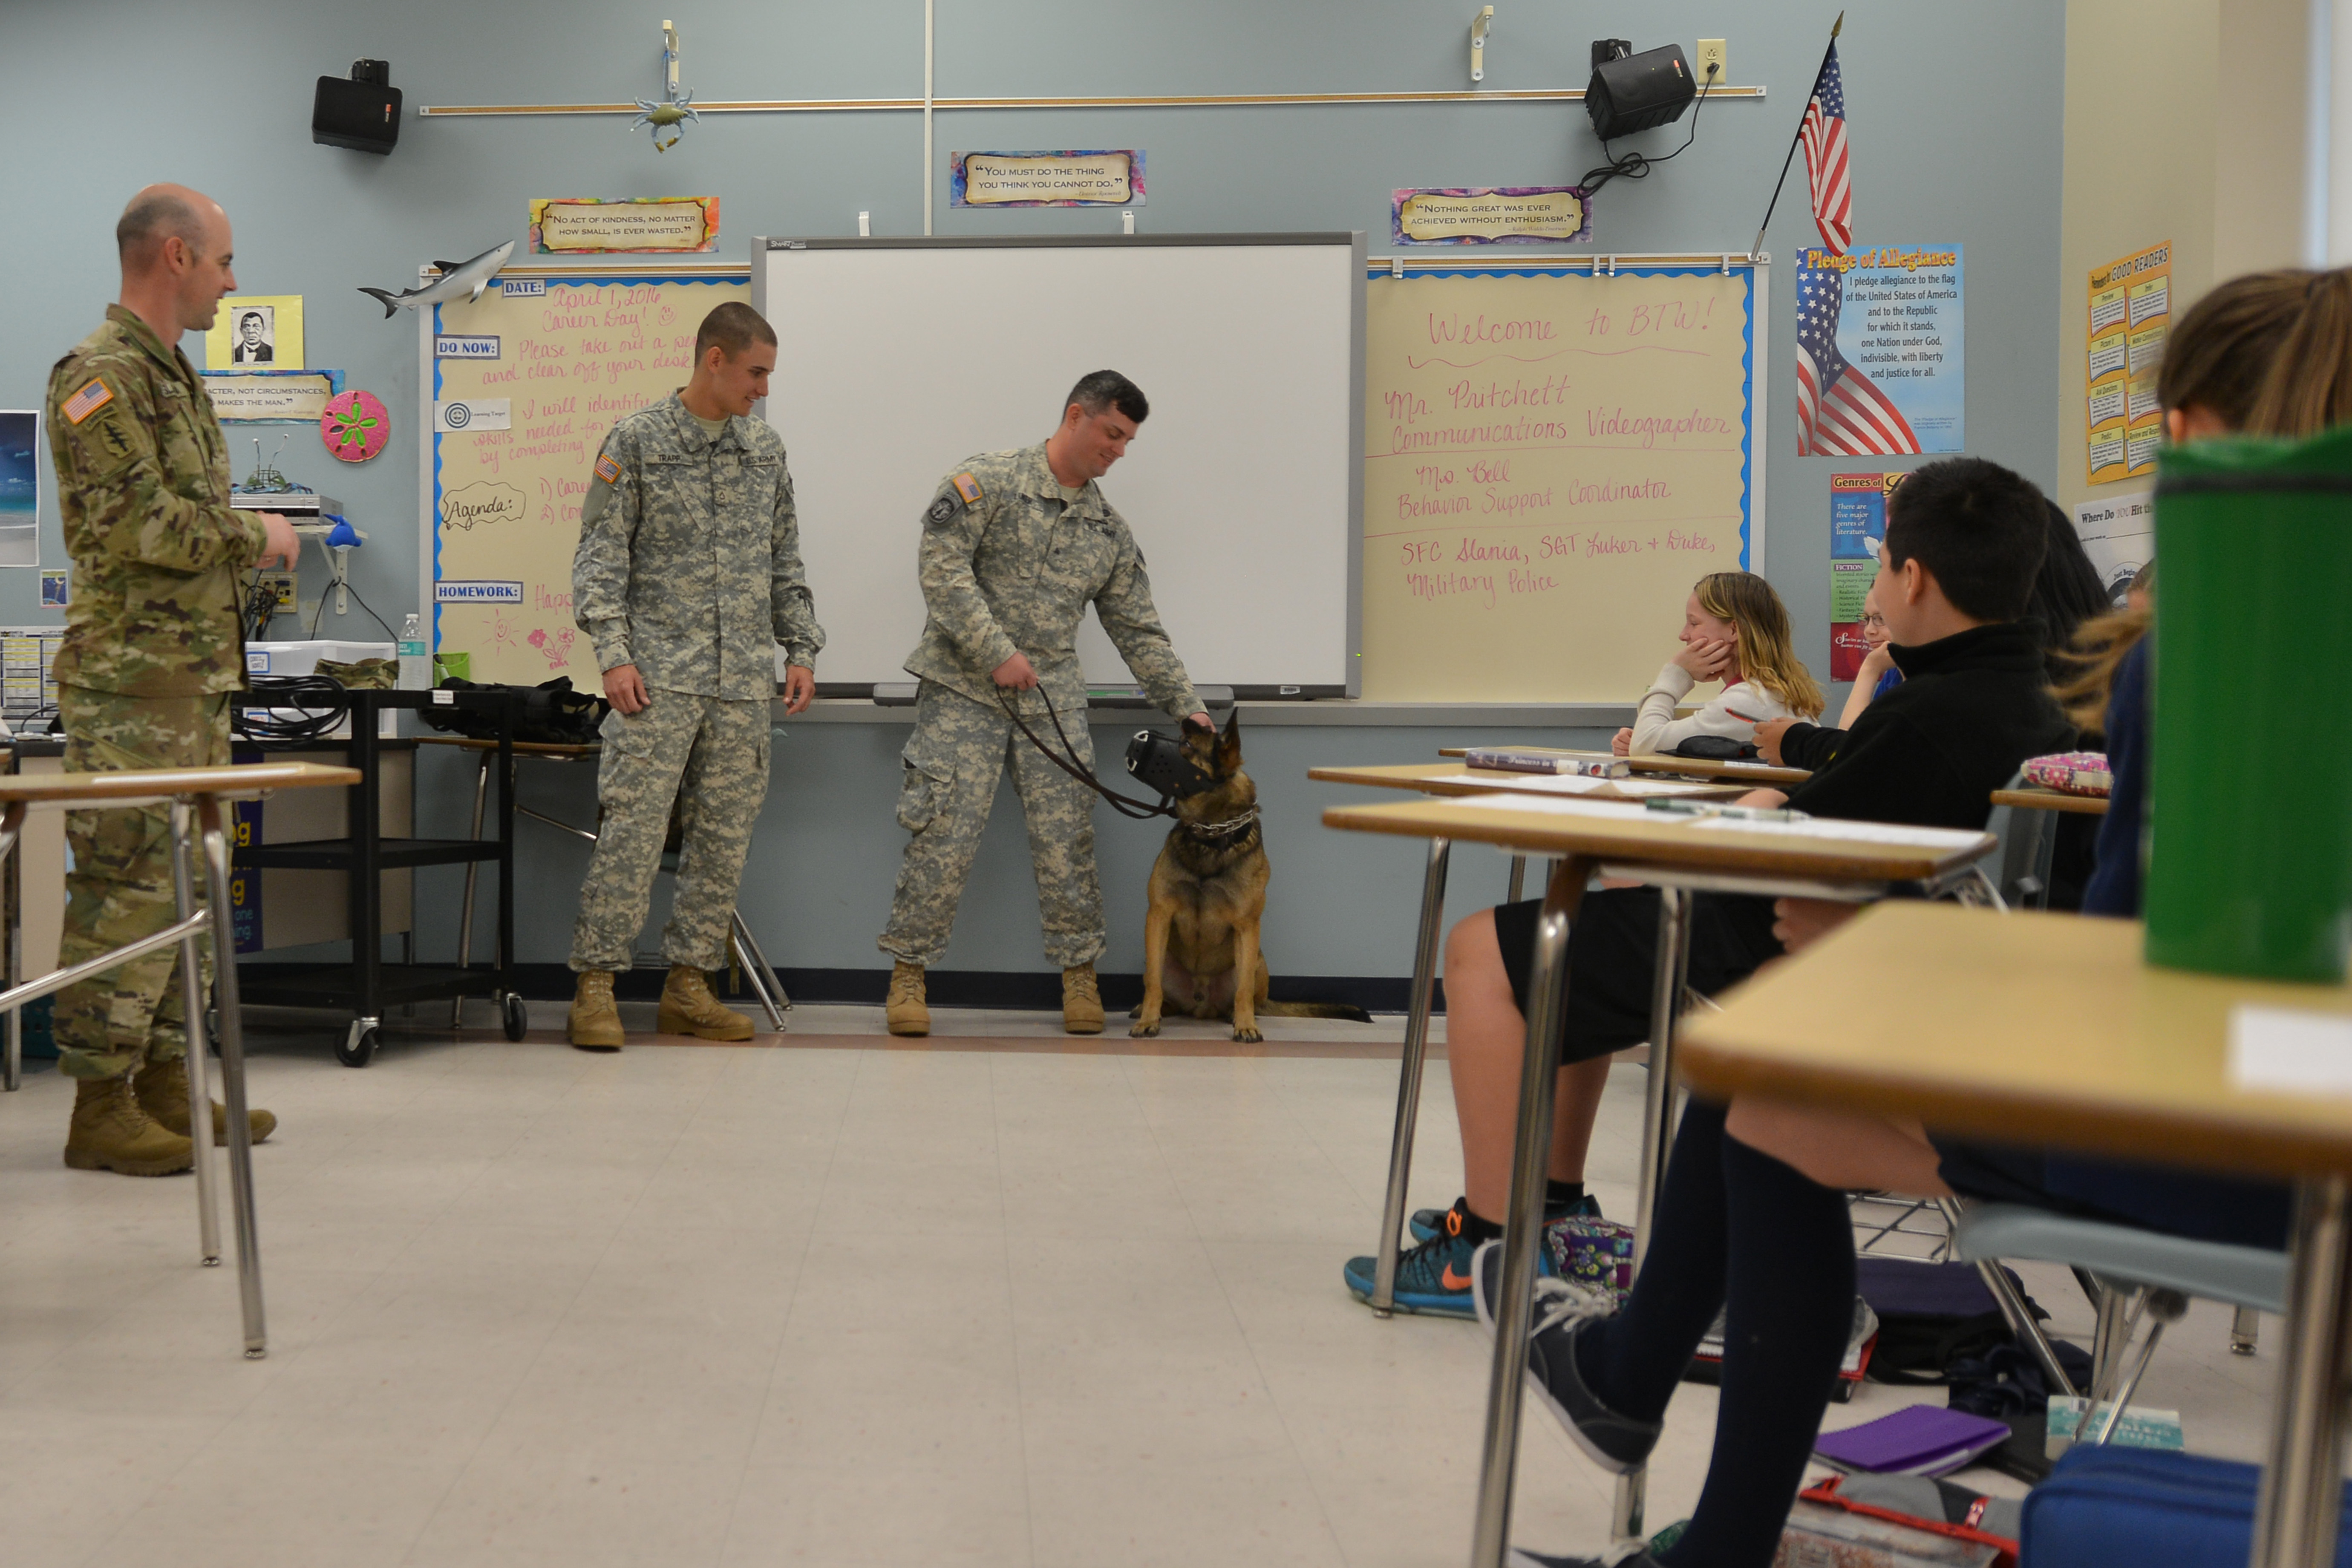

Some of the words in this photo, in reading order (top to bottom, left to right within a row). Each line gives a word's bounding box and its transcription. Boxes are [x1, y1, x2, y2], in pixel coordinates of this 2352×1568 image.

[975, 165, 1006, 176] “You
[602, 216, 646, 224] KINDNESS,
[1807, 248, 1856, 274] Pledge
[1860, 247, 1876, 268] of
[1878, 247, 1957, 273] Allegiance
[2111, 260, 2131, 282] GOOD
[2133, 246, 2169, 274] READERS
[505, 282, 541, 293] DATE:
[1850, 277, 1853, 286] I
[1854, 277, 1879, 288] pledge
[1880, 275, 1917, 287] allegiance
[1918, 276, 1926, 284] to
[1928, 275, 1940, 283] the
[1942, 274, 1956, 285] flag
[553, 287, 602, 313] April
[1846, 293, 1853, 302] of
[1855, 293, 1867, 301] the
[1868, 291, 1892, 301] United
[1894, 291, 1916, 300] States
[1918, 290, 1925, 299] of
[1927, 289, 1957, 299] America
[543, 310, 599, 332] Career
[1429, 312, 1557, 344] Welcome
[1585, 308, 1610, 336] to
[1629, 297, 1715, 336] BTW!
[1868, 308, 1882, 316] and
[1884, 308, 1891, 316] to
[1893, 307, 1904, 315] the
[1906, 306, 1938, 317] Republic
[1868, 323, 1879, 332] for
[1880, 322, 1901, 331] which
[1903, 322, 1908, 331] it
[1911, 321, 1936, 332] stands,
[439, 343, 457, 353] DO
[462, 343, 495, 353] NOW:
[519, 339, 569, 361] Please
[581, 337, 612, 355] take
[619, 335, 647, 353] out
[653, 337, 667, 350] a
[1876, 337, 1900, 347] Nation
[1902, 337, 1923, 346] under
[1925, 336, 1943, 347] God,
[1861, 353, 1900, 364] indivisible,
[1902, 352, 1917, 361] with
[1919, 352, 1944, 363] liberty
[482, 363, 520, 385] and
[528, 362, 567, 379] clear
[574, 361, 601, 383] off
[607, 359, 646, 384] your
[1871, 370, 1885, 378] and
[1886, 369, 1910, 380] justice
[1912, 368, 1922, 377] for
[1924, 368, 1936, 377] all.
[522, 399, 535, 420] I
[543, 396, 576, 416] will
[1385, 391, 1433, 424] Mr.
[1448, 375, 1571, 410] Pritchett
[473, 432, 514, 447] skills
[526, 418, 574, 440] needed
[580, 418, 604, 440] for
[1392, 415, 1567, 454] Communications
[1587, 407, 1731, 449] Videographer
[480, 448, 499, 473] by
[509, 438, 585, 464] completing
[658, 455, 681, 463] TRAPP
[1466, 459, 1510, 483] Bell
[1834, 477, 1871, 487] Genres
[1873, 477, 1882, 487] of
[539, 476, 553, 502] 1)
[1397, 491, 1472, 520] Behavior
[1481, 487, 1554, 516] Support
[1568, 477, 1672, 505] Coordinator
[447, 496, 513, 531] Agenda:
[540, 504, 555, 525] 2)
[1850, 512, 1868, 520] major
[2081, 513, 2104, 524] Where
[2104, 509, 2114, 520] Do
[2131, 504, 2142, 516] Hit
[1401, 541, 1442, 566] SFC
[1540, 533, 1581, 559] SGT
[439, 587, 518, 597] HOMEWORK:
[1407, 573, 1496, 610] Military
[1509, 569, 1559, 594] Police
